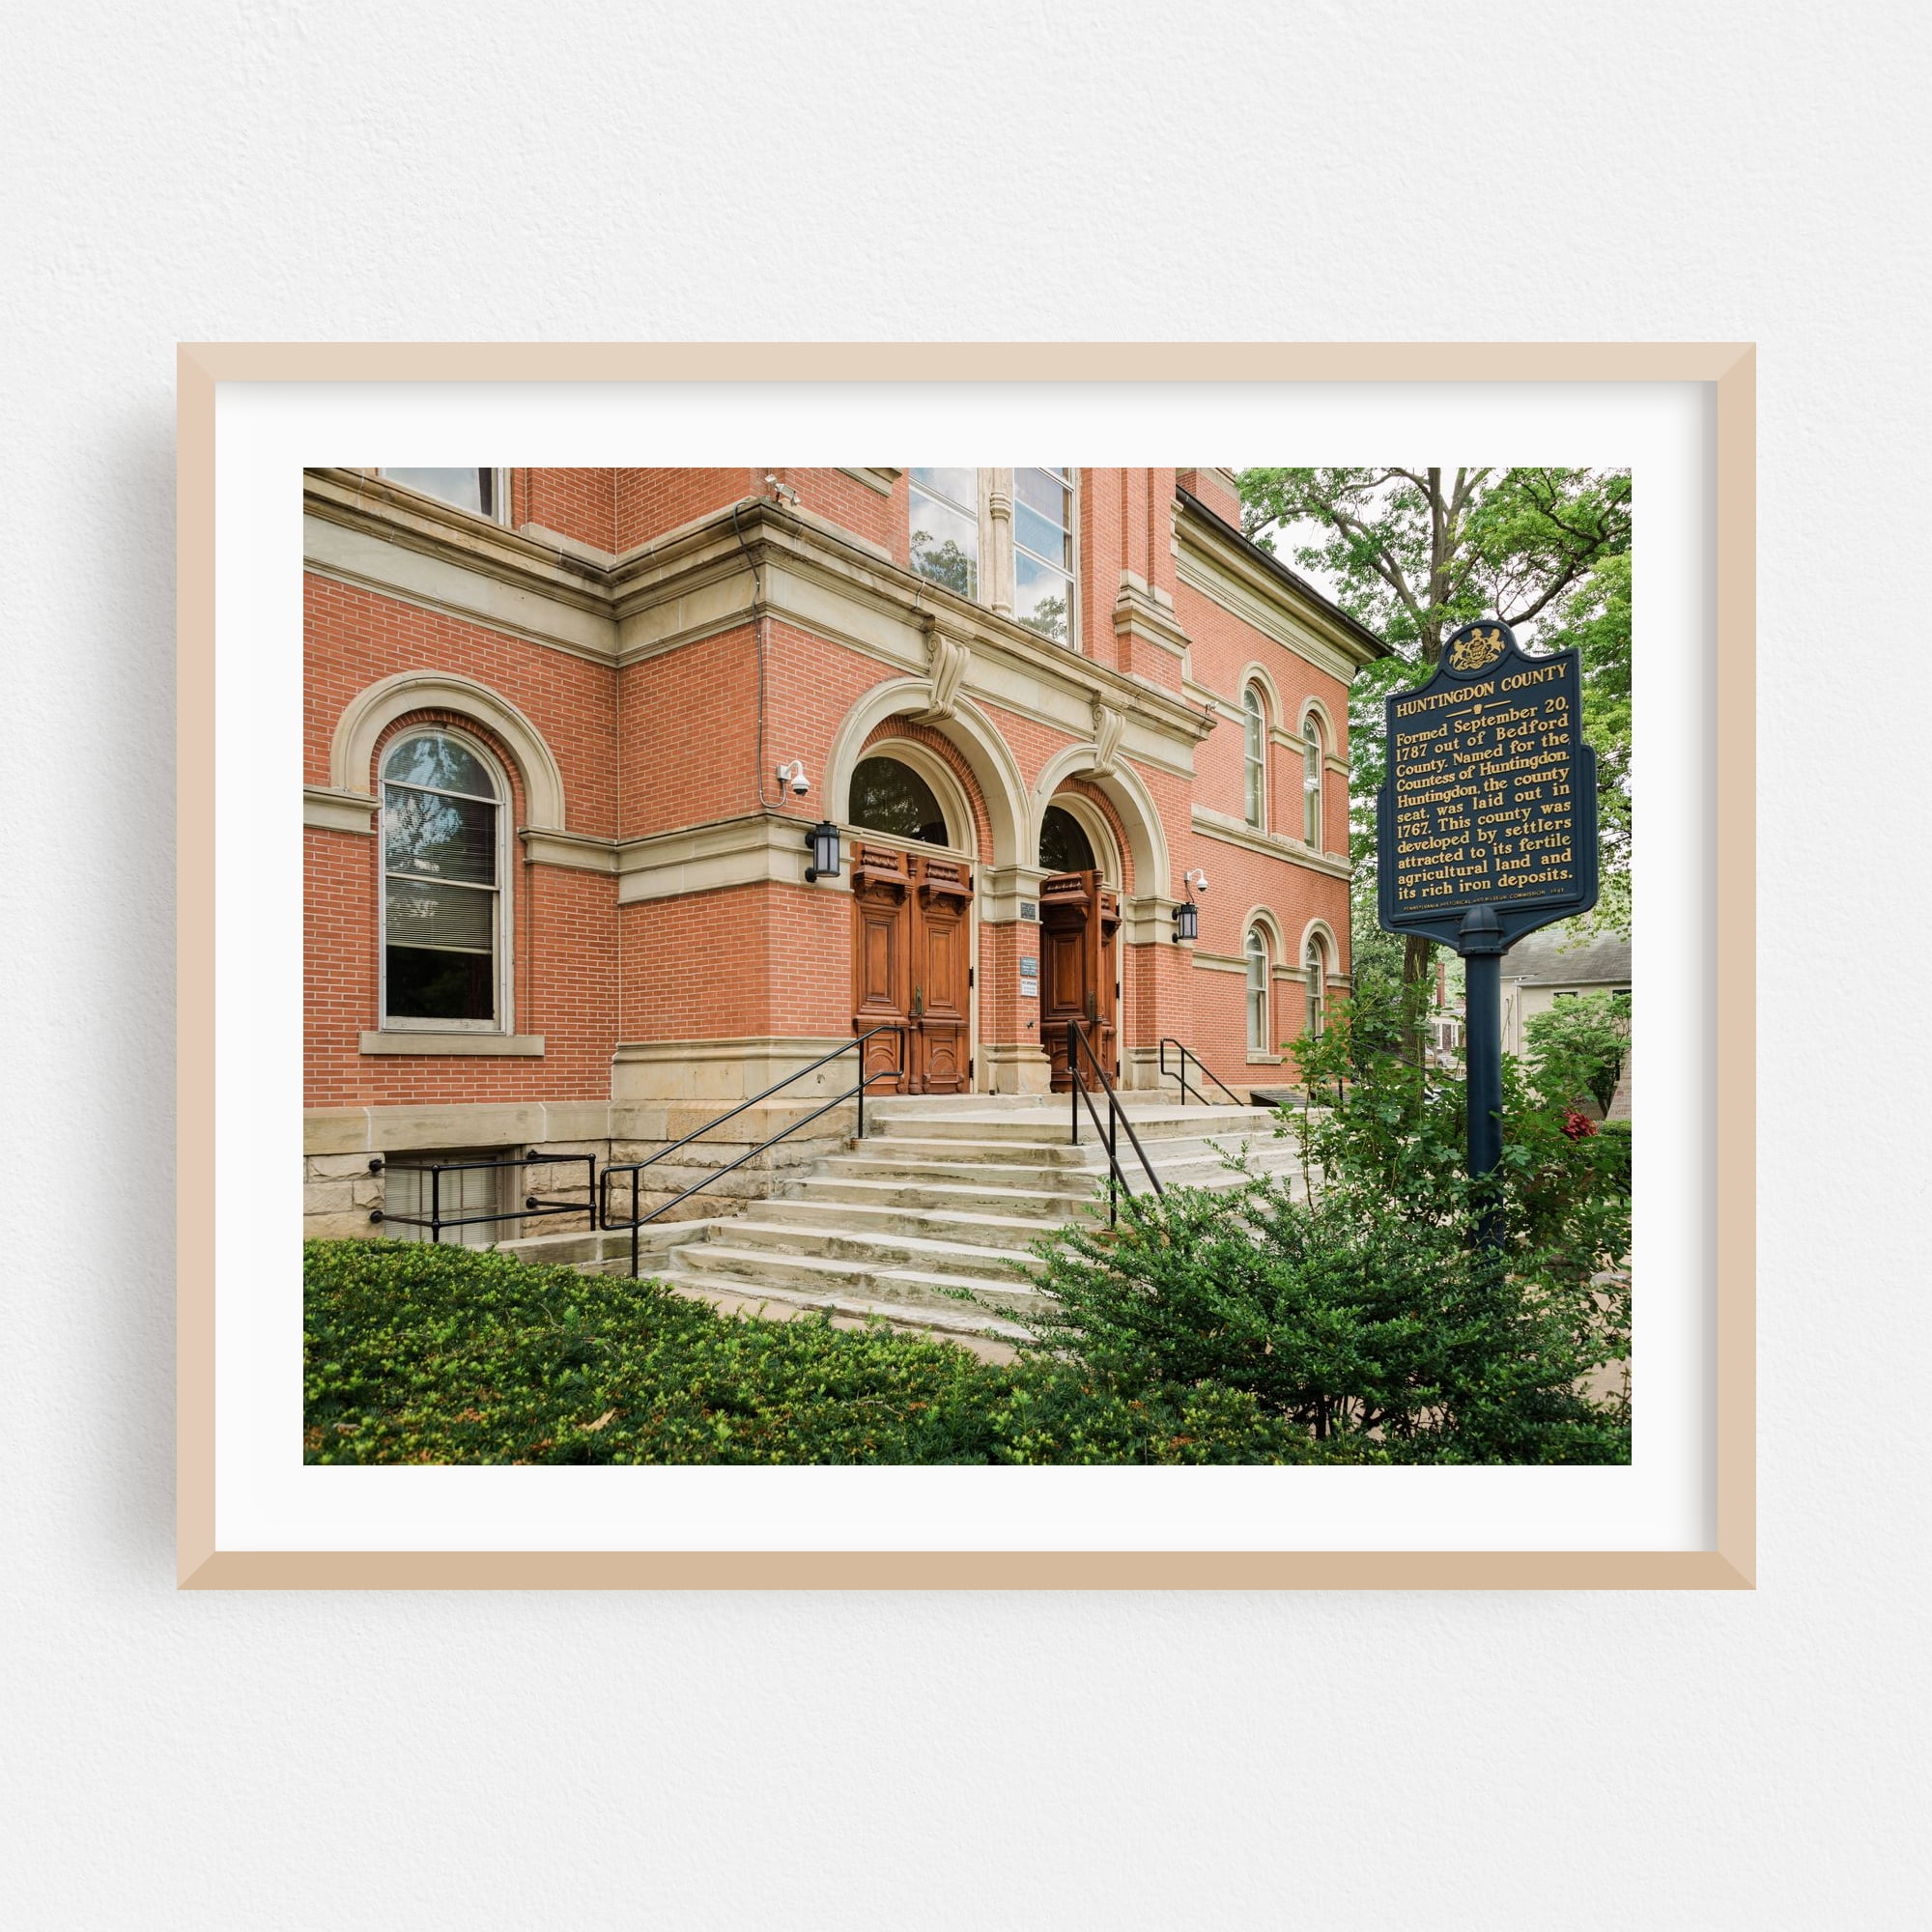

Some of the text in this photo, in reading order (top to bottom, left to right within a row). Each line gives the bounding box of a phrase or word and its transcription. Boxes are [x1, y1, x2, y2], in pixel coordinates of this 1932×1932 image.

[1396, 664, 1567, 718] HUNTINGDON COUNTY
[1396, 724, 1448, 747] Formed
[1454, 706, 1538, 734] September
[1396, 713, 1569, 762] 1787 out of Bedford
[1396, 732, 1570, 778] County. Named for the
[1396, 773, 1456, 792] Countess
[1458, 764, 1476, 780] of
[1483, 777, 1508, 792] the
[1513, 767, 1570, 786] county
[1435, 803, 1463, 816] was
[1472, 791, 1504, 810] laid
[1514, 786, 1543, 803] out
[1552, 782, 1571, 797] in
[1397, 800, 1572, 839] 1767. This county was
[1397, 817, 1572, 854] developed by settlers
[1398, 834, 1572, 869] attracted to its fertile
[1398, 848, 1573, 888] agricultural land and
[1398, 868, 1574, 900] its rich iron deposits.
